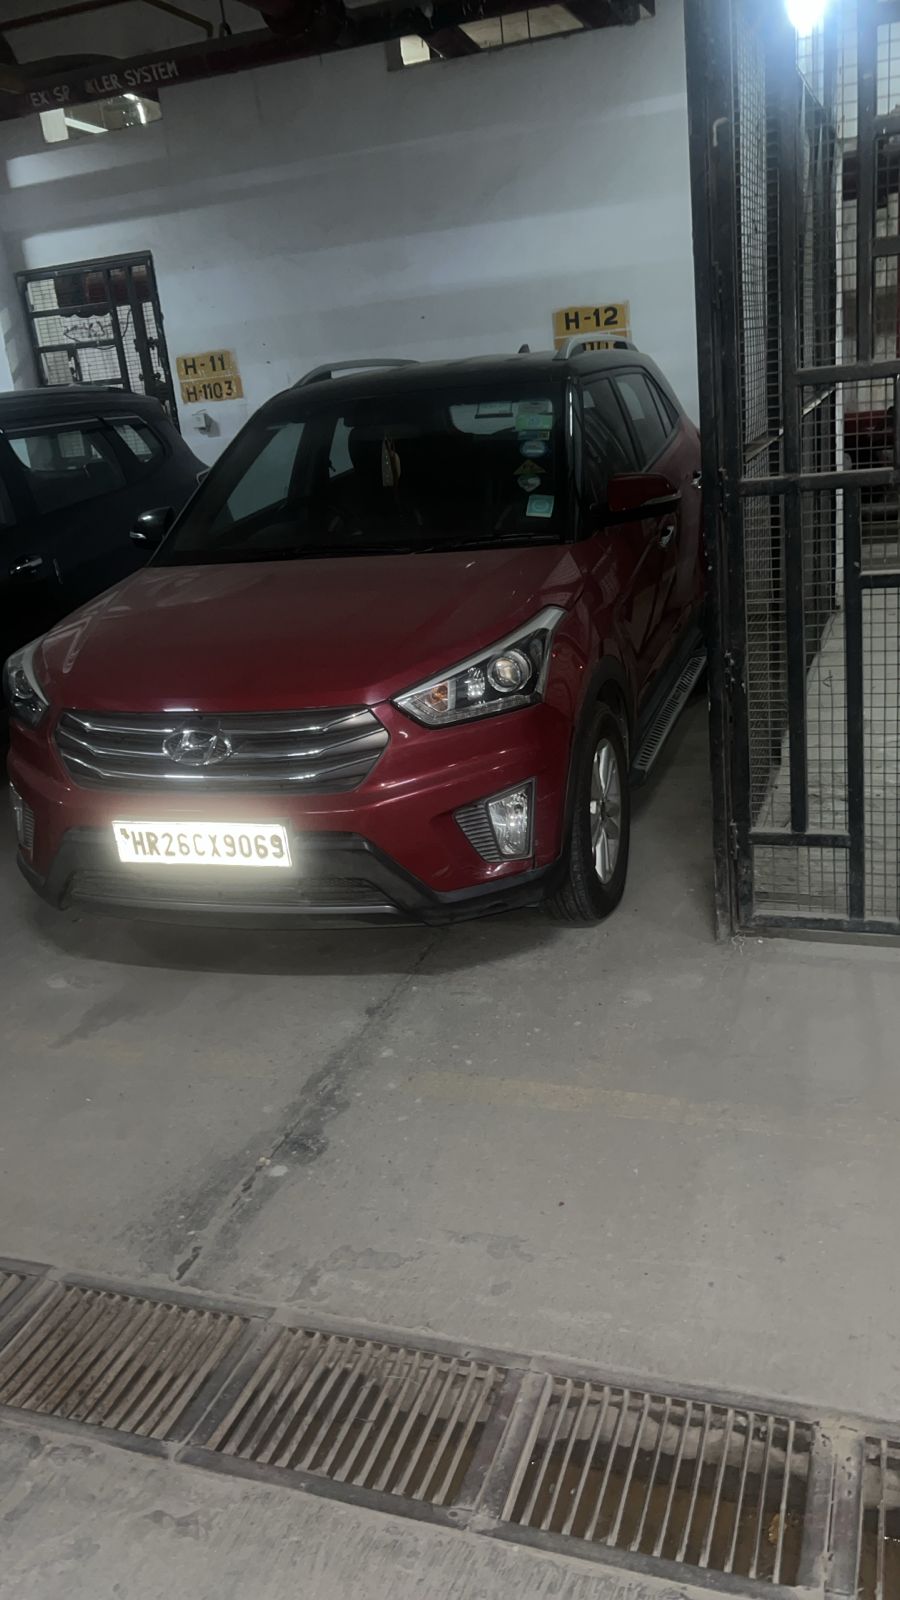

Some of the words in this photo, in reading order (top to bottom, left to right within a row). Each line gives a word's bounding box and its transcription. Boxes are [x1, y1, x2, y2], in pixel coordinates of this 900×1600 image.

[30, 91, 49, 107] EX
[123, 60, 180, 87] SYSTEM
[564, 306, 618, 331] H-12
[183, 354, 225, 375] H-11
[186, 380, 233, 402] H-1103
[131, 830, 286, 860] HR26CX9069
